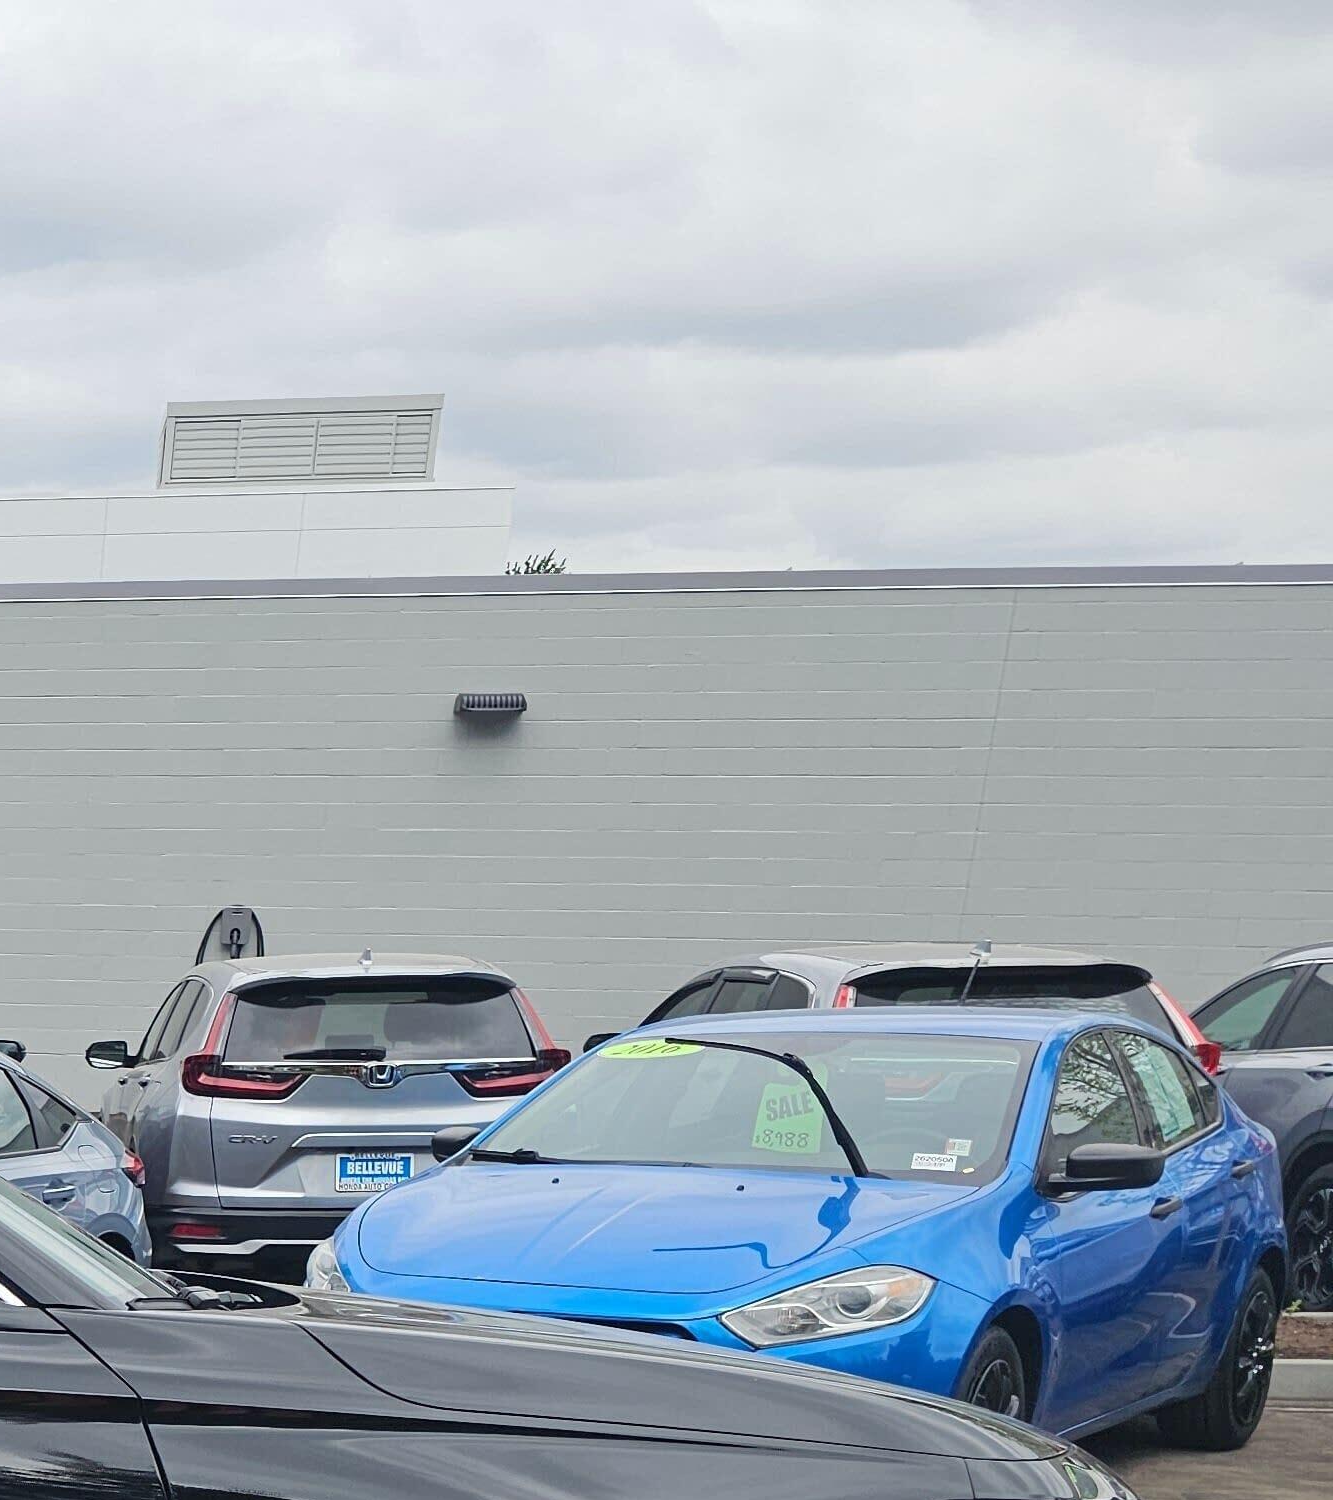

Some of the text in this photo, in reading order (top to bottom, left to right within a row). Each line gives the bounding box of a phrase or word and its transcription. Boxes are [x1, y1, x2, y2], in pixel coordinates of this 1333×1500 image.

[765, 1090, 815, 1121] SALE
[228, 1134, 278, 1144] CR-V
[346, 1161, 404, 1175] BELLEVUE
[338, 1182, 363, 1191] HONDA
[364, 1182, 383, 1191] AUTO
